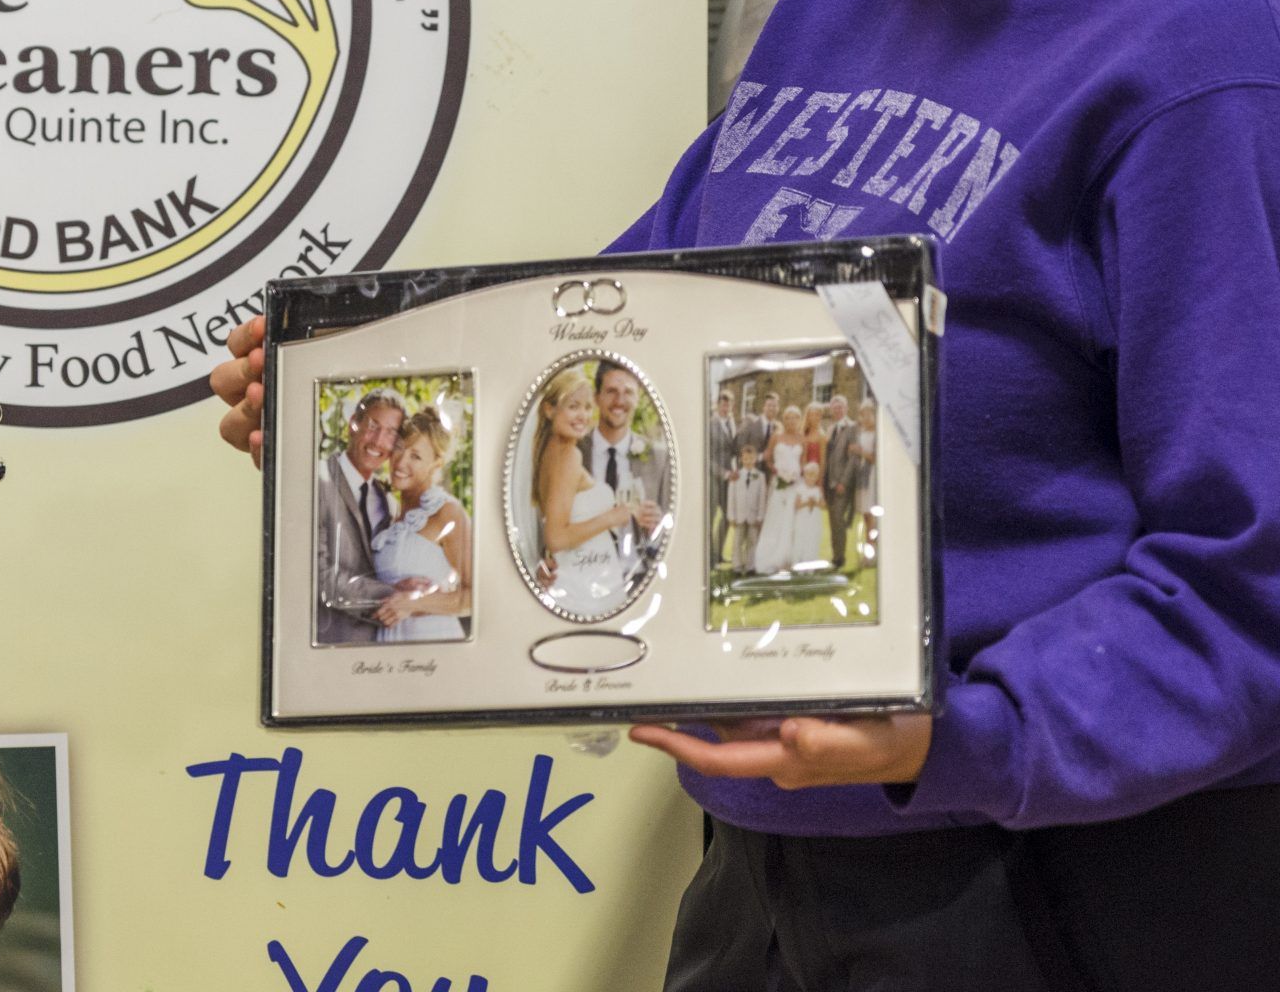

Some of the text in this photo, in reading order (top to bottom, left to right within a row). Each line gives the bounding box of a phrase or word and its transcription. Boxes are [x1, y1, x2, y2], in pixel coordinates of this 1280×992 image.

[5, 106, 229, 148] Quinte Inc.
[711, 81, 1021, 244] WESTERN
[57, 175, 220, 264] BANK
[24, 330, 155, 390] Food
[549, 317, 648, 344] Wedding Day
[186, 747, 596, 894] Thank
